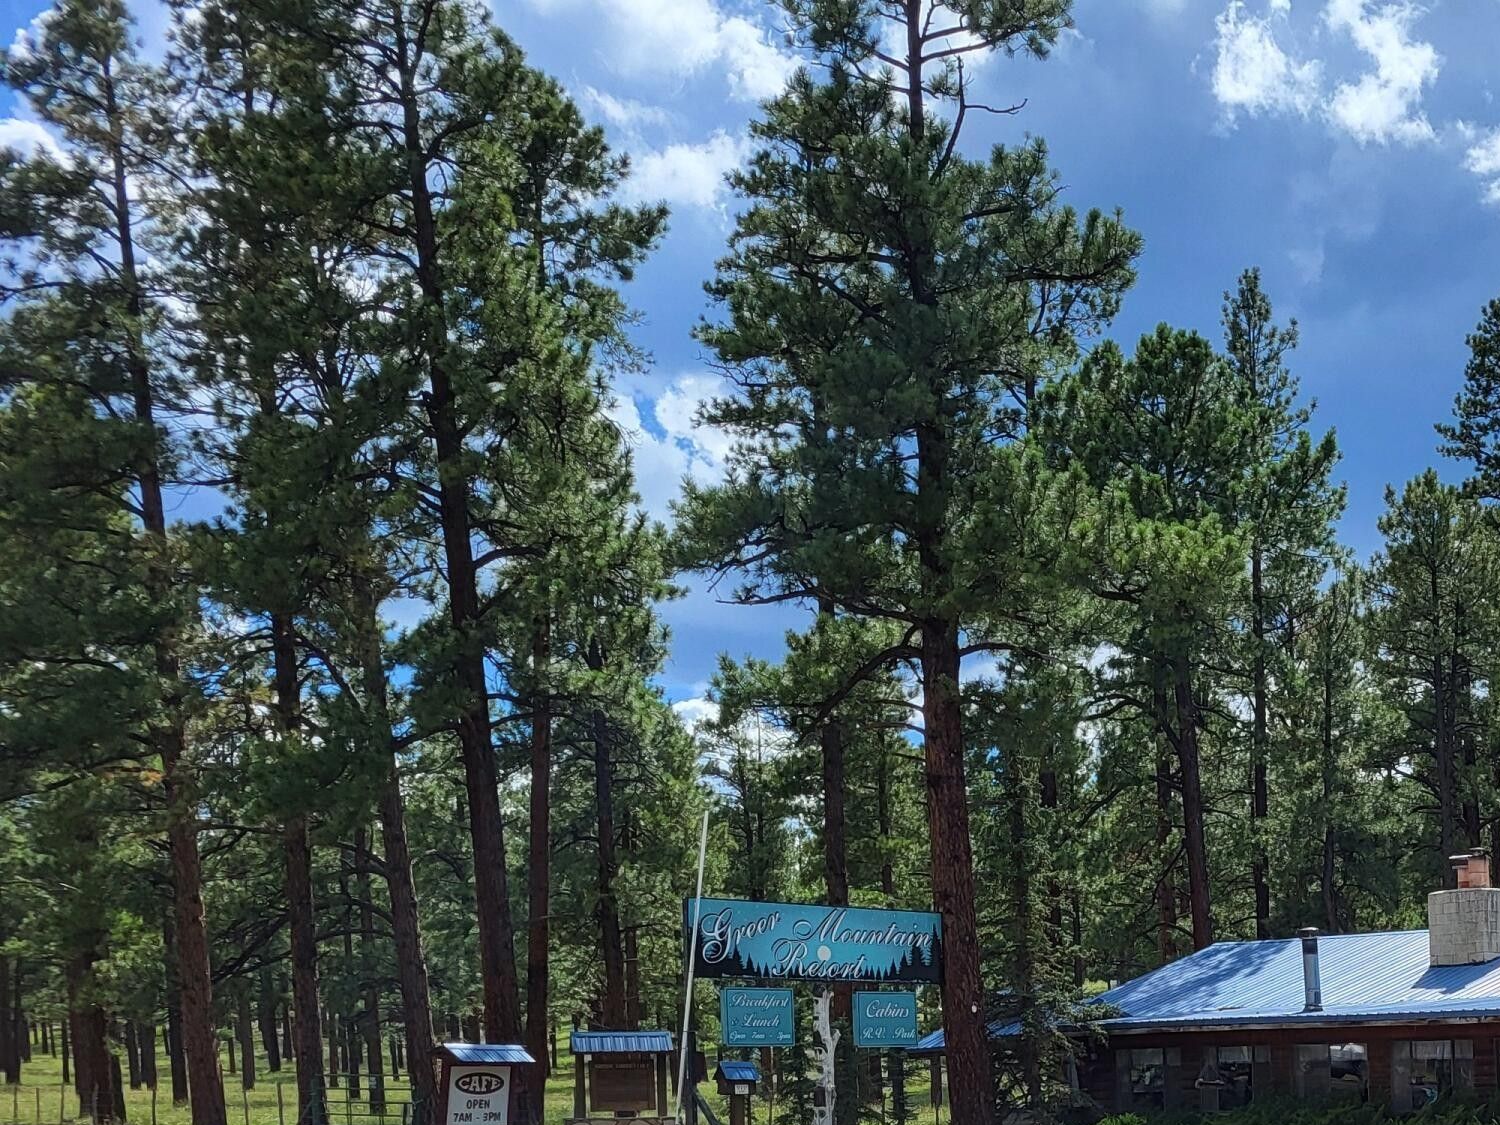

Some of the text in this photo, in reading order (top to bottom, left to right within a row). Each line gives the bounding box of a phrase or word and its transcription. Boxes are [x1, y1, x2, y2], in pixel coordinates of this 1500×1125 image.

[700, 907, 932, 964] Greer Mountain
[770, 937, 866, 979] Resort
[729, 992, 789, 1010] Breakfast
[866, 999, 909, 1018] Cabins
[742, 1013, 780, 1027] Lunch
[892, 1026, 916, 1039] Park
[458, 1075, 501, 1092] CAFE
[466, 1099, 491, 1109] OPEN
[453, 1112, 473, 1122] 7AM
[483, 1111, 502, 1121] 3PM
